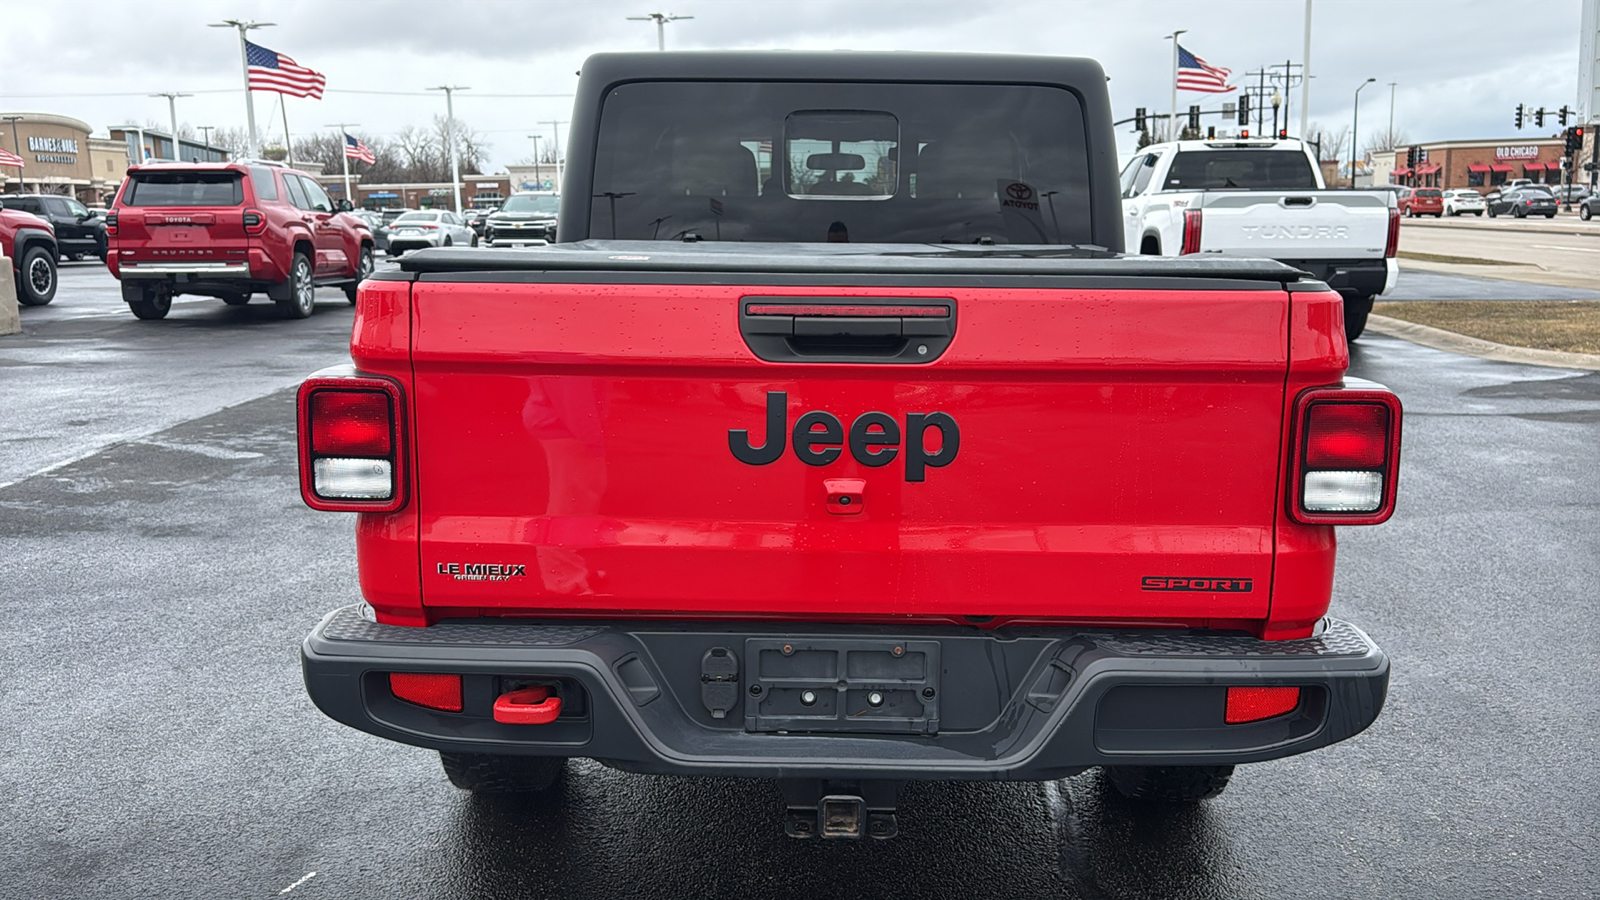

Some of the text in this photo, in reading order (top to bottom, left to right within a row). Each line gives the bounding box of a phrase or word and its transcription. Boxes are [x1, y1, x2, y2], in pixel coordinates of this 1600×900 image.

[28, 136, 56, 152] BARNES
[1496, 146, 1538, 157] OLD CHICAGO
[1242, 225, 1349, 239] TUNDRA
[728, 391, 960, 482] Jeep
[437, 563, 527, 576] LE MIEUX
[1141, 577, 1253, 592] SPORT
